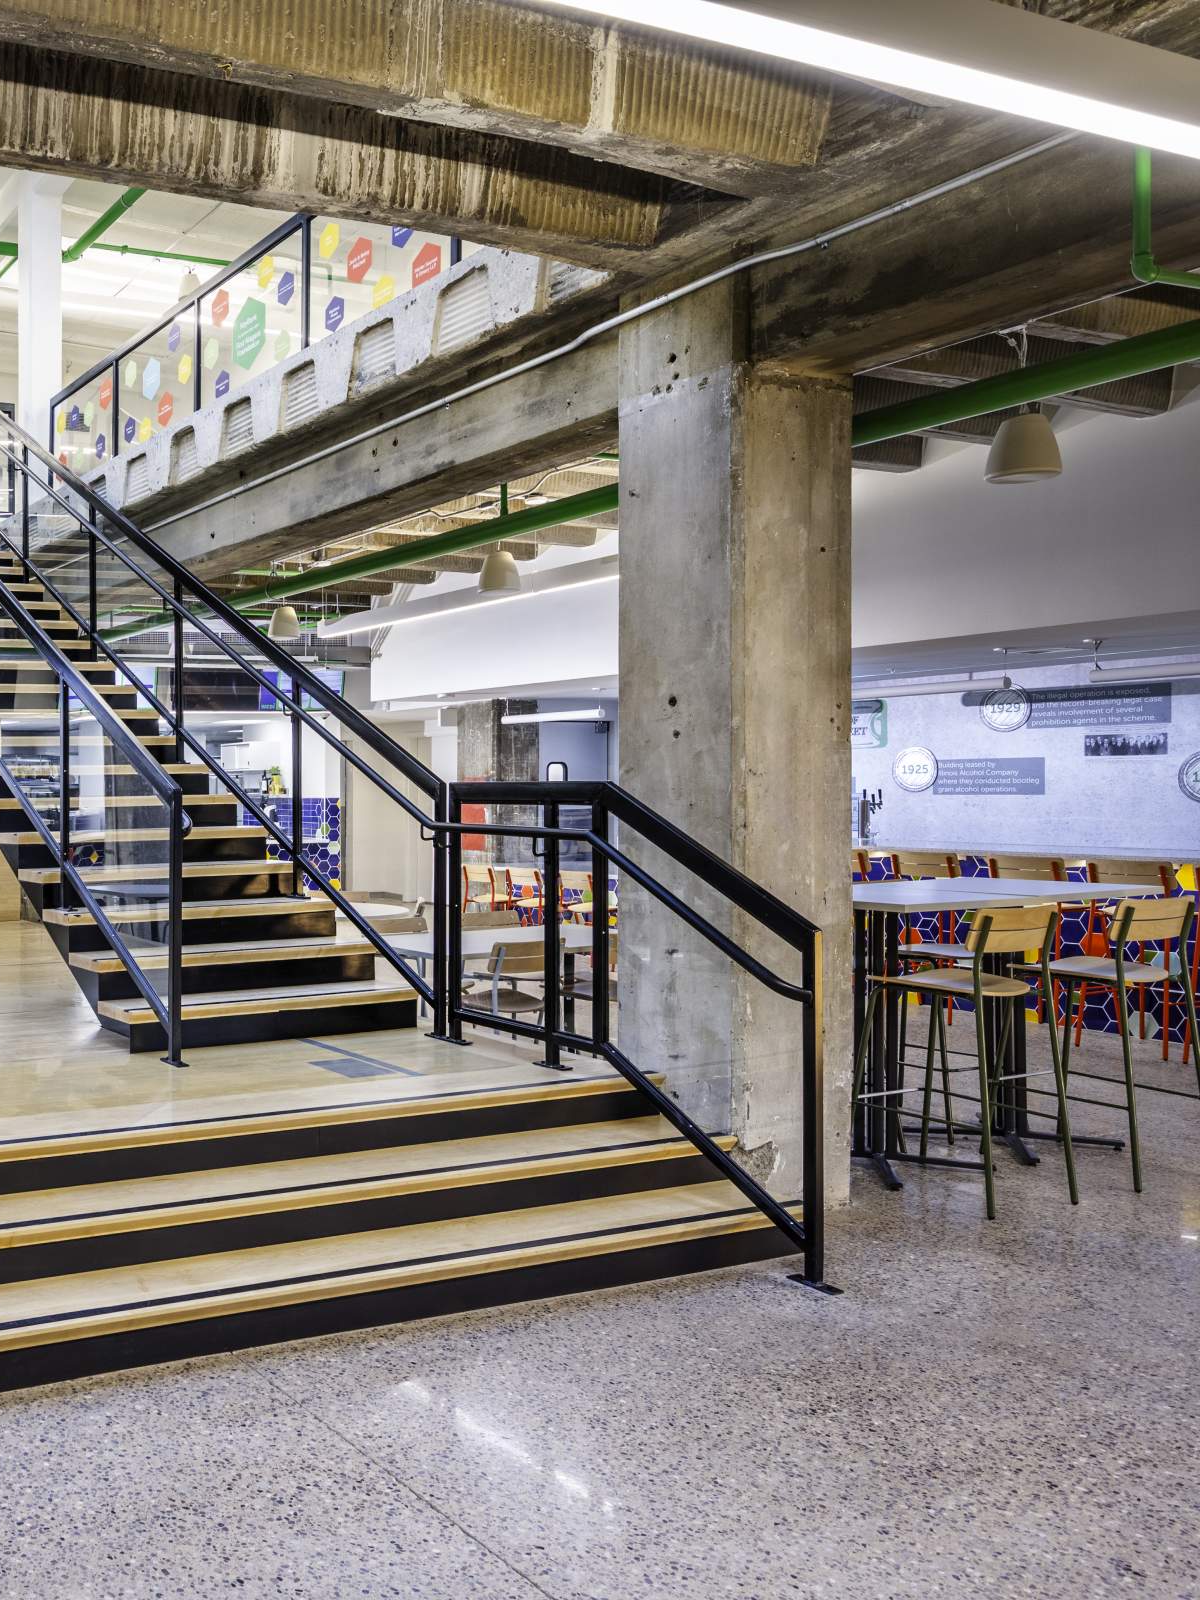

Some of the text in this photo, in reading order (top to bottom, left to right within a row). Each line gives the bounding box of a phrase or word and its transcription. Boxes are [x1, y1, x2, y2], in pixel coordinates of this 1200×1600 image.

[1046, 691, 1068, 701] illegal
[1069, 689, 1106, 700] operation
[990, 702, 1021, 714] 1929
[1031, 701, 1046, 709] and
[1047, 700, 1059, 709] the
[1060, 698, 1121, 708] record-breaking
[1123, 697, 1143, 706] legal
[1031, 705, 1143, 717] reveals involvement of several
[1031, 717, 1071, 728] prohibition
[1072, 717, 1098, 726] agents
[1108, 715, 1121, 723] the
[1123, 714, 1157, 722] scheme.
[902, 764, 929, 775] 1925
[965, 761, 986, 769] leased
[987, 761, 996, 769] by
[959, 769, 985, 777] Alcohol
[986, 769, 1019, 778] Company
[959, 777, 973, 786] they
[974, 776, 1011, 784] conducted
[1012, 777, 1040, 786] bootleg
[955, 785, 980, 793] alcohol
